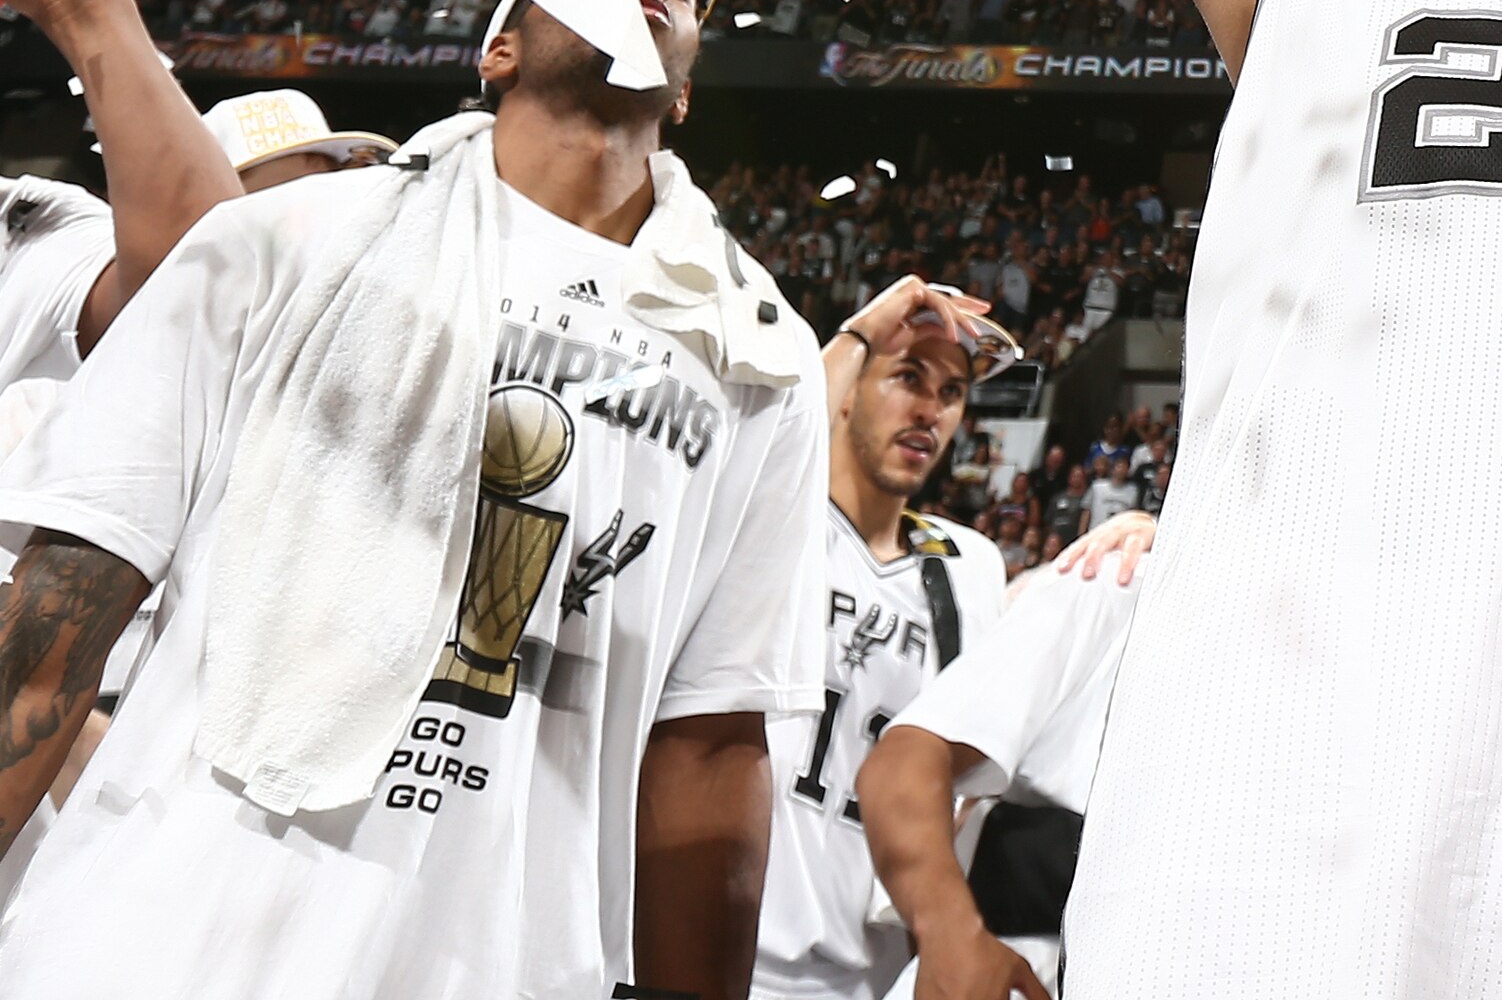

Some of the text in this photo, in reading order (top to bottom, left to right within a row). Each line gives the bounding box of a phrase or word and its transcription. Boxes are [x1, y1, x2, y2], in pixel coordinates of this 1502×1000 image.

[303, 41, 482, 67] CHAMPI
[559, 288, 605, 308] adidas
[410, 717, 466, 748] GO
[384, 750, 490, 791] PURS
[386, 784, 443, 815] GO
